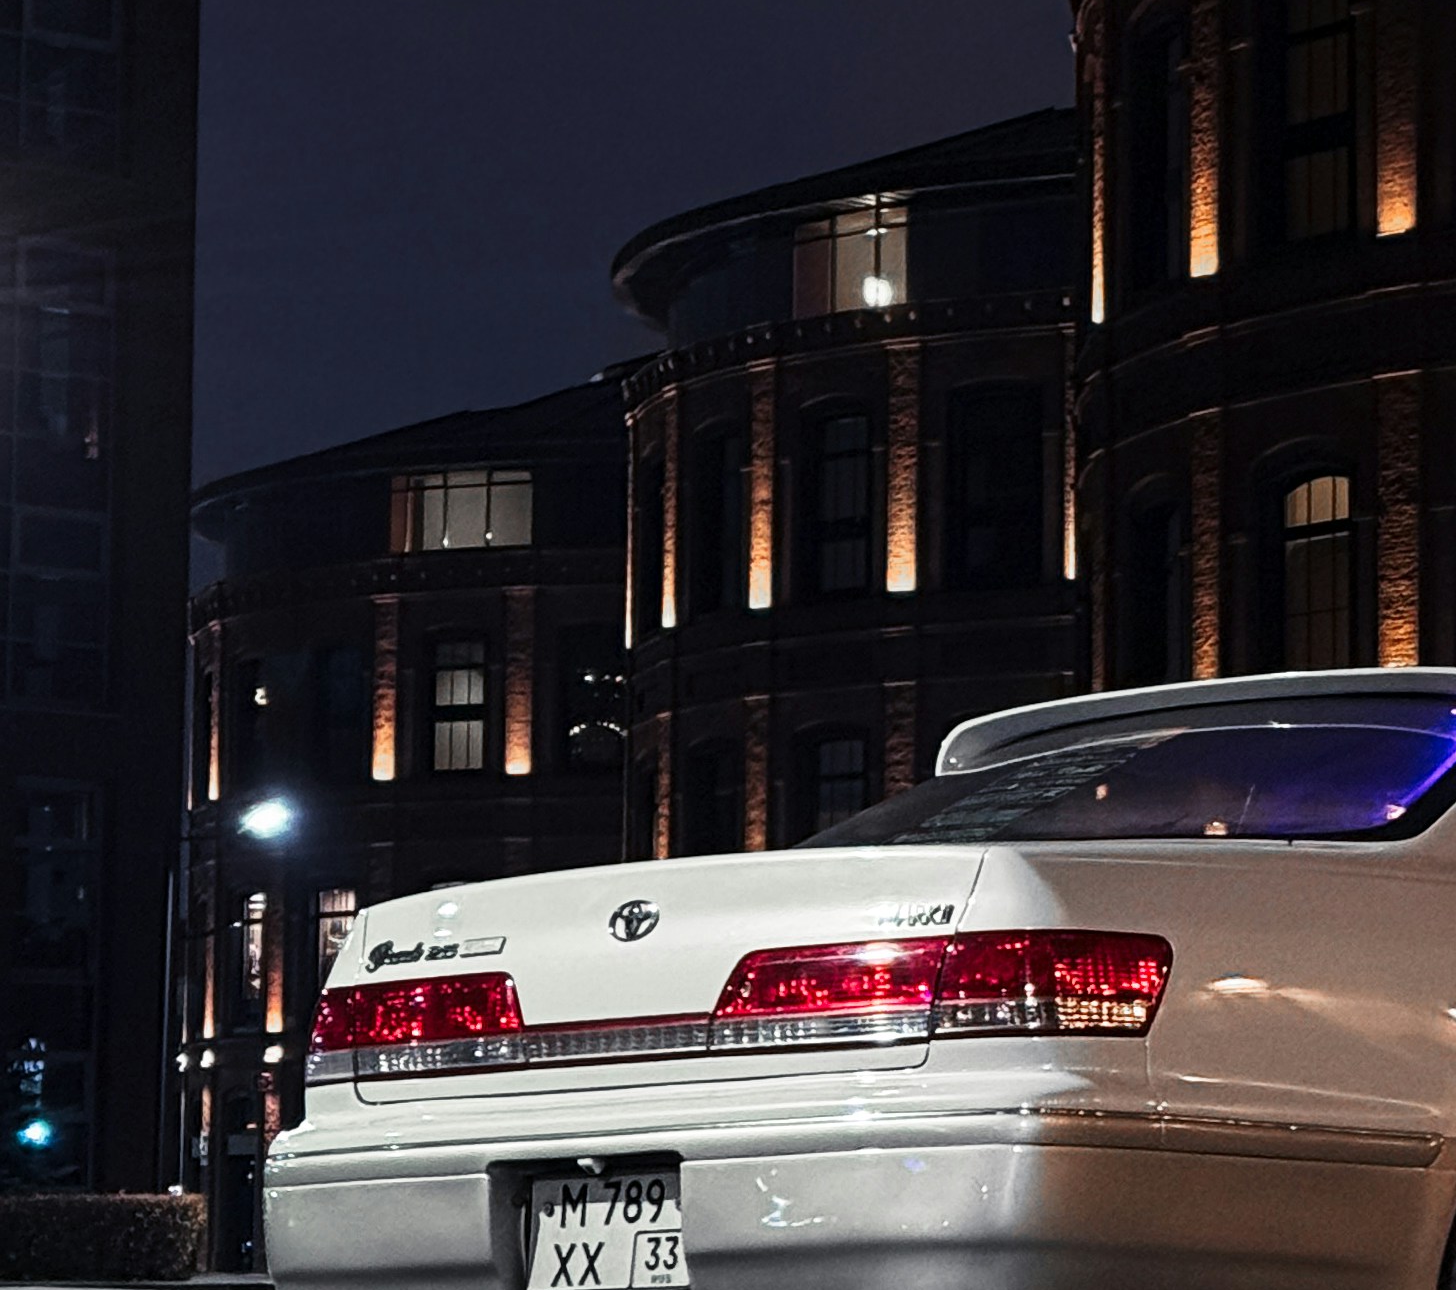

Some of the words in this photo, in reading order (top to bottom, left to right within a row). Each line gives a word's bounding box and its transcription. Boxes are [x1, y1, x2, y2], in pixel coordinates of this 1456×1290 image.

[560, 1183, 588, 1228] M
[604, 1179, 665, 1225] 789
[550, 1242, 605, 1287] XX
[645, 1236, 679, 1270] 33
